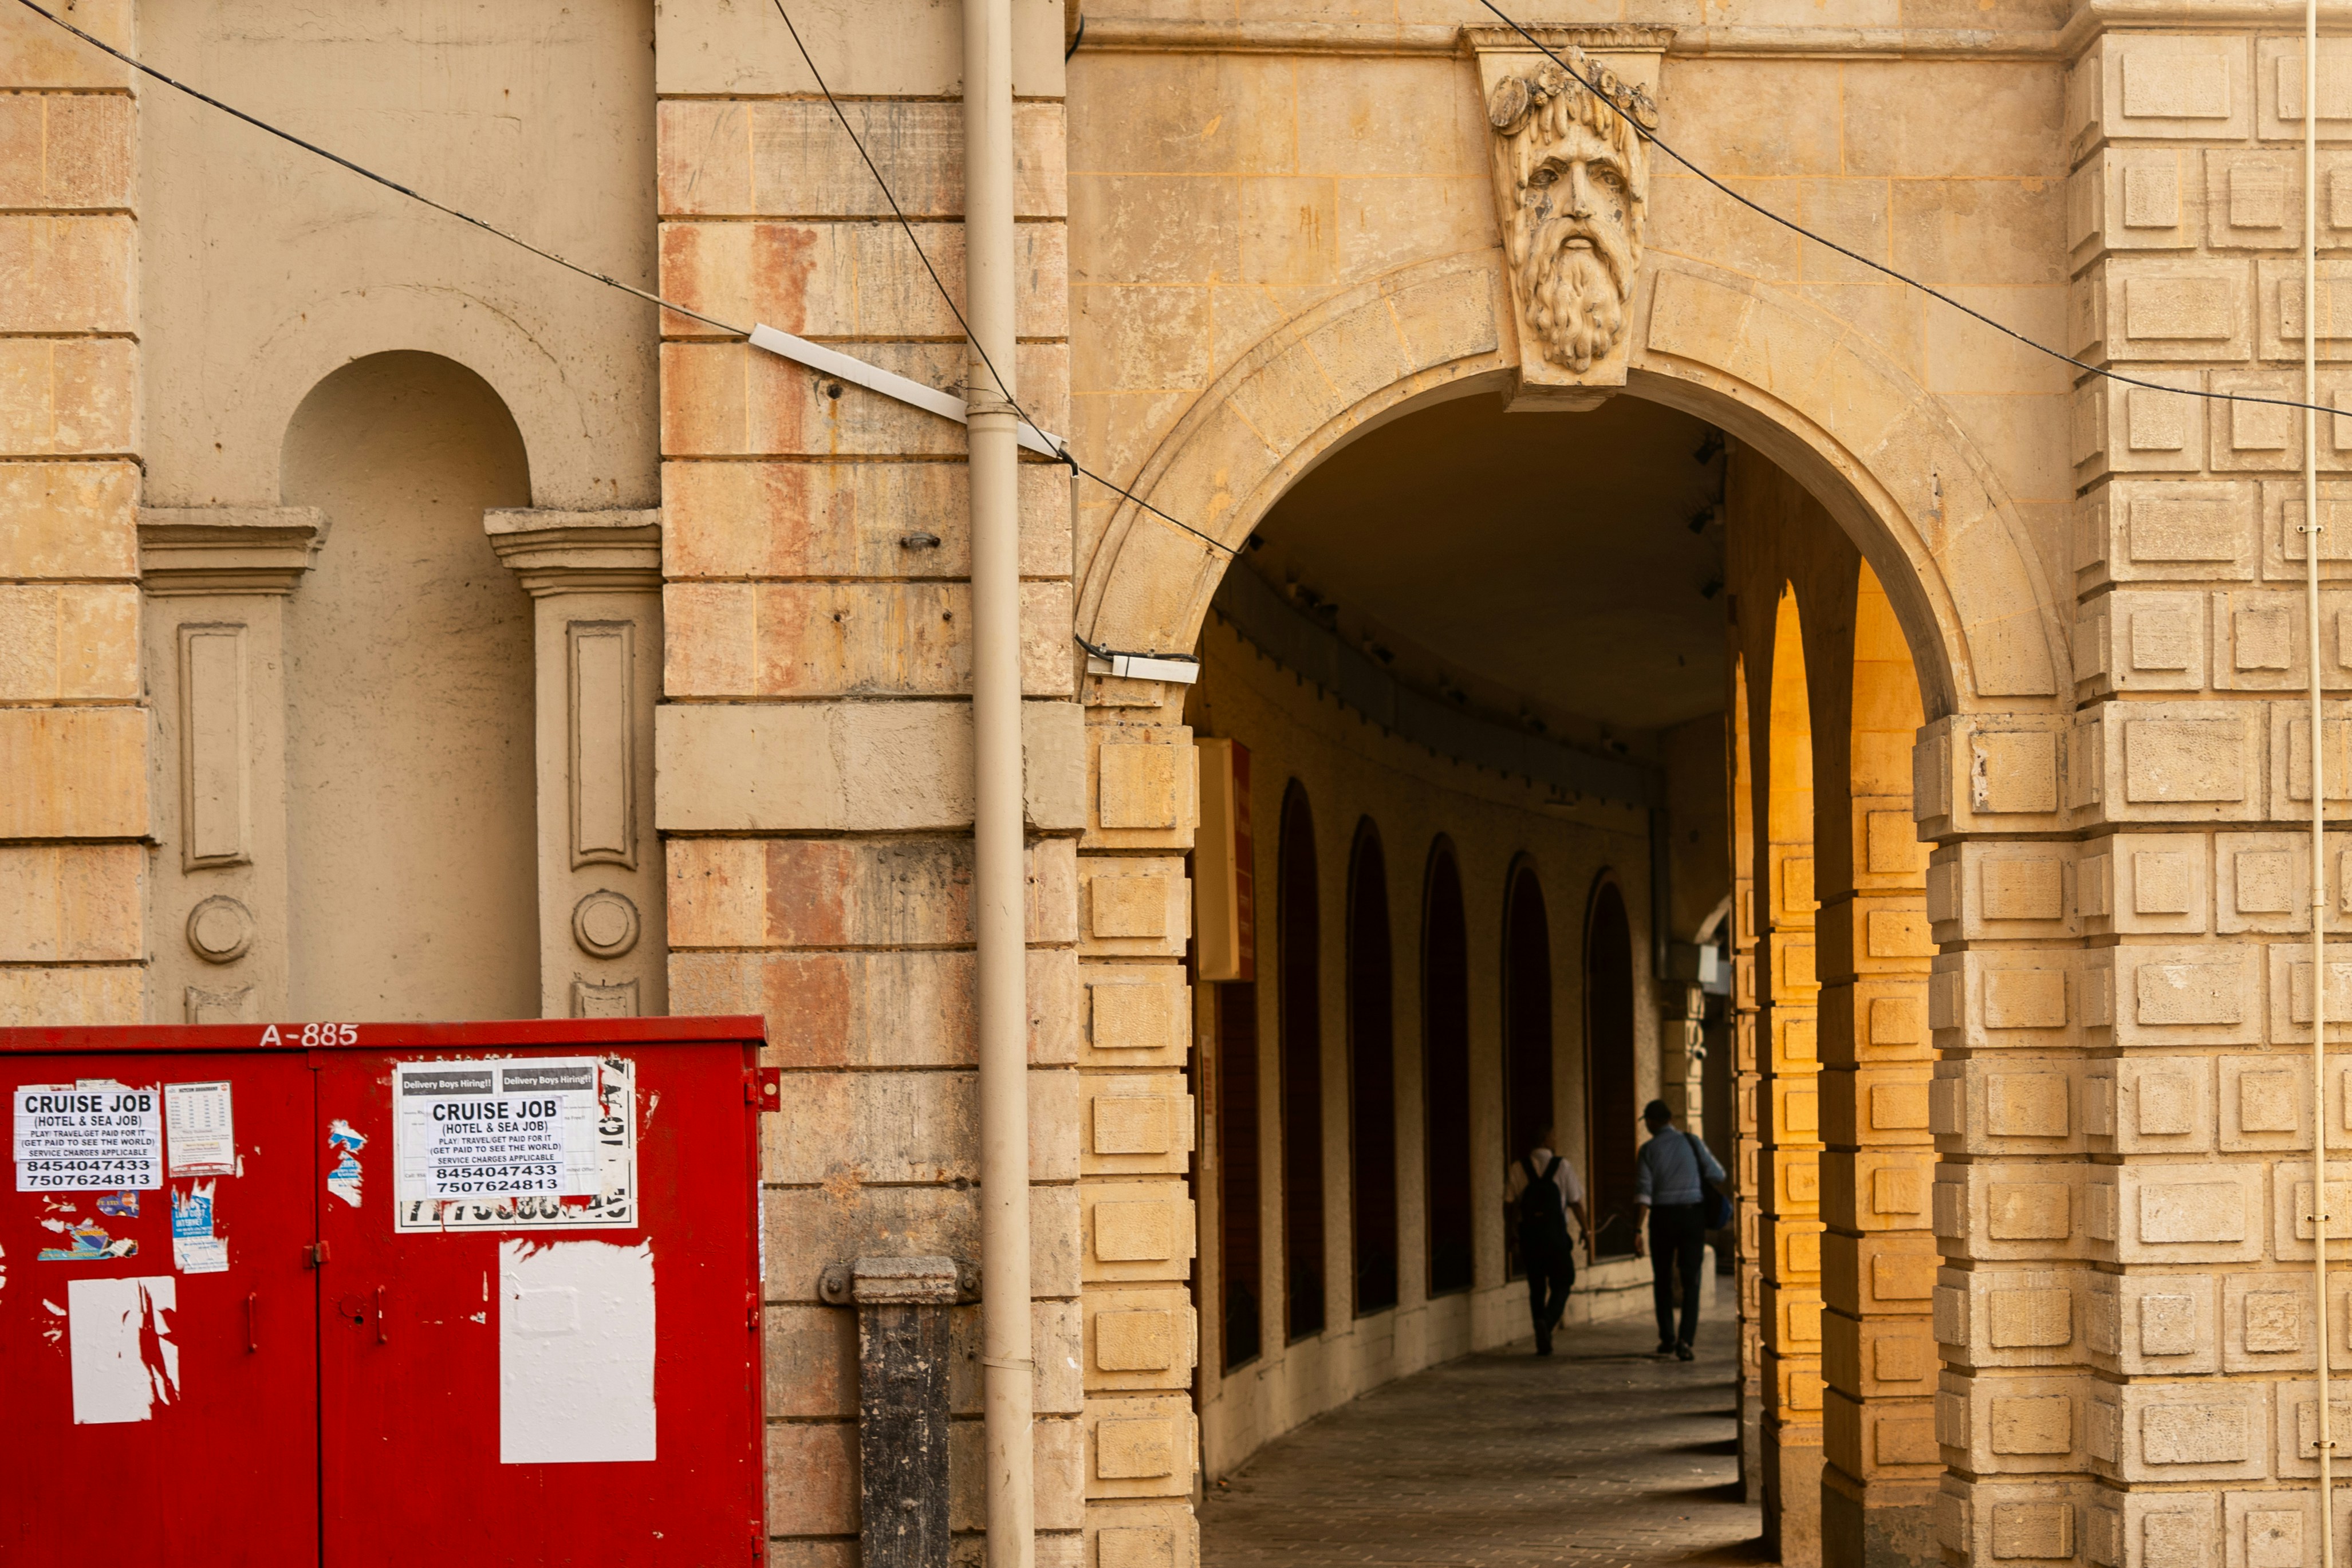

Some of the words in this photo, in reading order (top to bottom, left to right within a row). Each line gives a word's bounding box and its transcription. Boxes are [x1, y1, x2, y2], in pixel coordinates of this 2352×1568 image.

[260, 1023, 359, 1046] A-885
[404, 1081, 438, 1089] Delivery
[439, 1080, 459, 1089] Boys
[460, 1079, 491, 1088] Hiring!!
[503, 1077, 538, 1085] Delivery
[539, 1076, 559, 1085] Boys
[560, 1075, 592, 1084] Hiring!!
[25, 1095, 102, 1113] CRUISE
[110, 1094, 151, 1112] JOB
[432, 1102, 509, 1121] CRUISE
[516, 1100, 556, 1118] JOB
[34, 1116, 74, 1129] (HOTEL
[79, 1116, 86, 1126] &
[91, 1116, 112, 1126] SEA
[116, 1116, 141, 1128] JOB)
[442, 1123, 482, 1137] (HOTEL
[487, 1122, 494, 1132] &
[498, 1122, 519, 1132] SEA
[523, 1121, 548, 1133] JOB)
[22, 1140, 41, 1148] (GET
[121, 1138, 155, 1147] WORLD)
[430, 1147, 450, 1156] (GET
[527, 1143, 561, 1152] WORLD)
[472, 1155, 507, 1163] CHARGES
[509, 1154, 554, 1162] APPLICABLE
[27, 1160, 149, 1171] 8454047433
[436, 1165, 557, 1179] 8454047433
[27, 1174, 149, 1185] 7507624813
[436, 1179, 557, 1193] 7507624813
